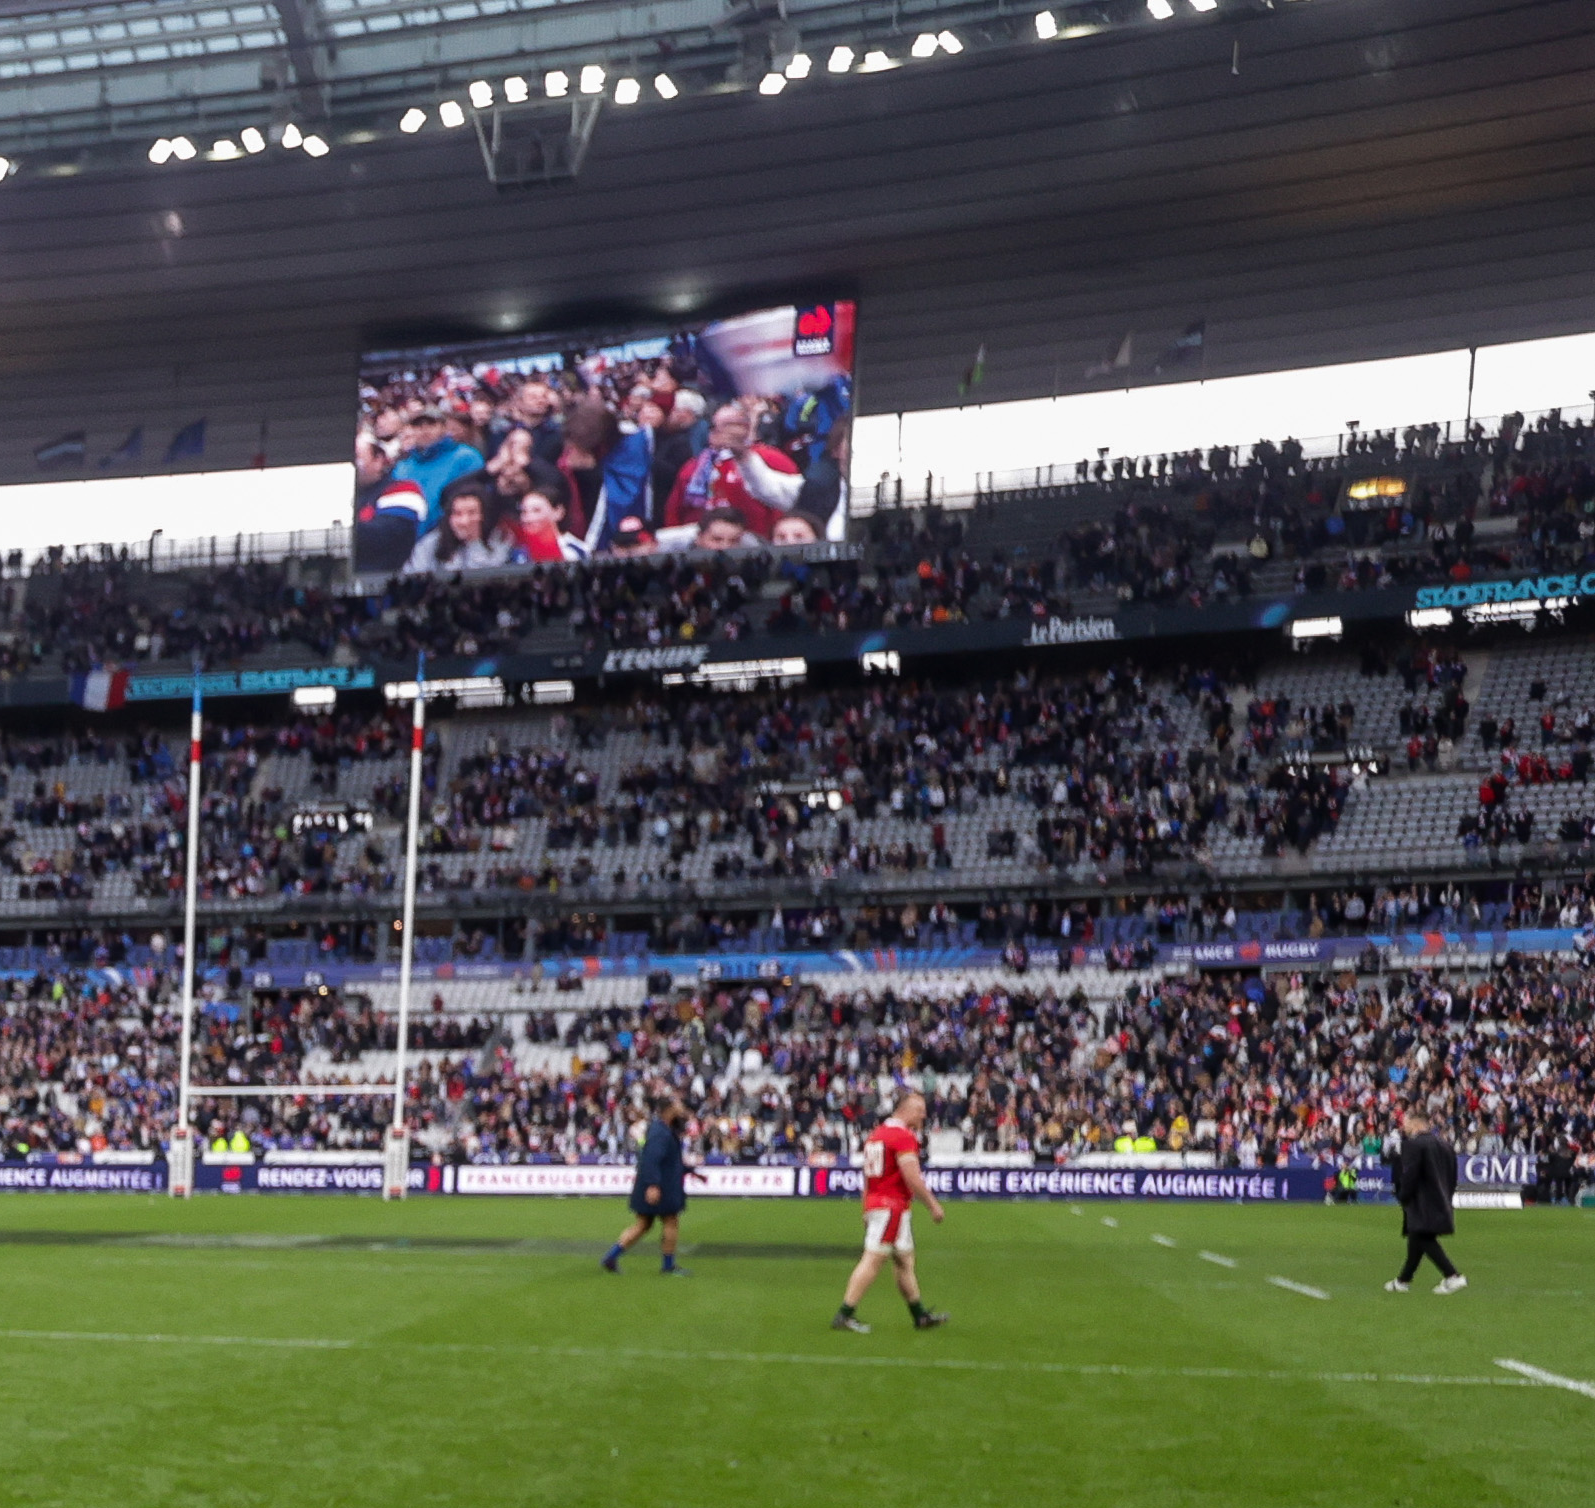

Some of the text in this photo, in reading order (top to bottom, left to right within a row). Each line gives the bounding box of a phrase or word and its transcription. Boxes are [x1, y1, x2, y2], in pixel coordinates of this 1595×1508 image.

[50, 1166, 152, 1190] AUGMENTÉE
[258, 1167, 383, 1188] RENDEZ-VOUS
[958, 1171, 998, 1193] UNE
[1005, 1166, 1136, 1195] EXPÉRIENCE
[1141, 1171, 1276, 1199] AUGMENTÉE
